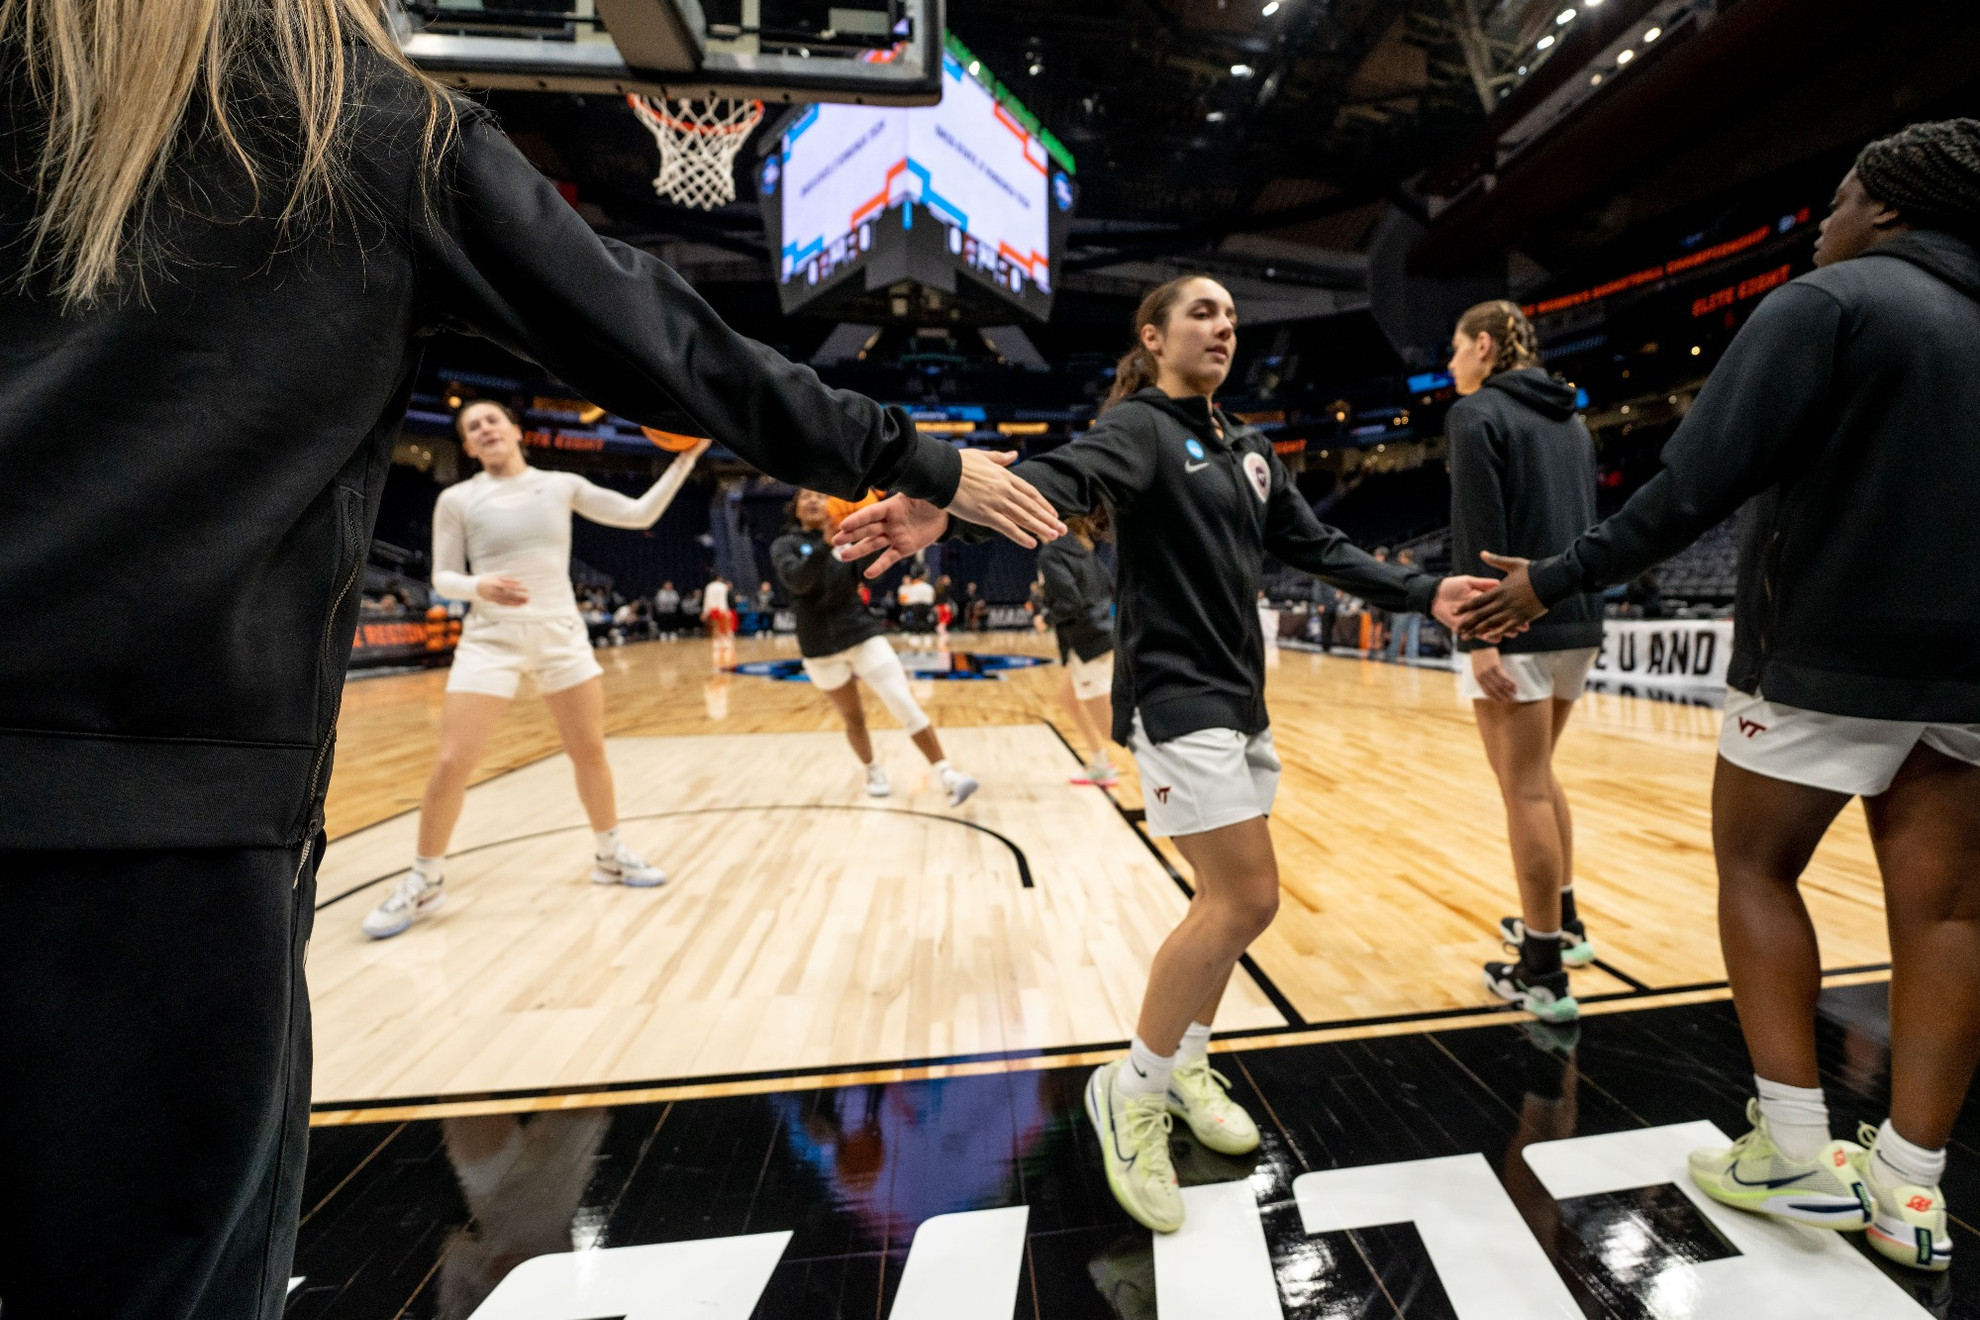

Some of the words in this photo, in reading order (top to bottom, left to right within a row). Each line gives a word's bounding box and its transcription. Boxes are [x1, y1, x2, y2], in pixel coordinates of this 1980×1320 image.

[1620, 632, 1635, 672] U
[1646, 630, 1716, 675] AND
[1738, 716, 1766, 738] VT
